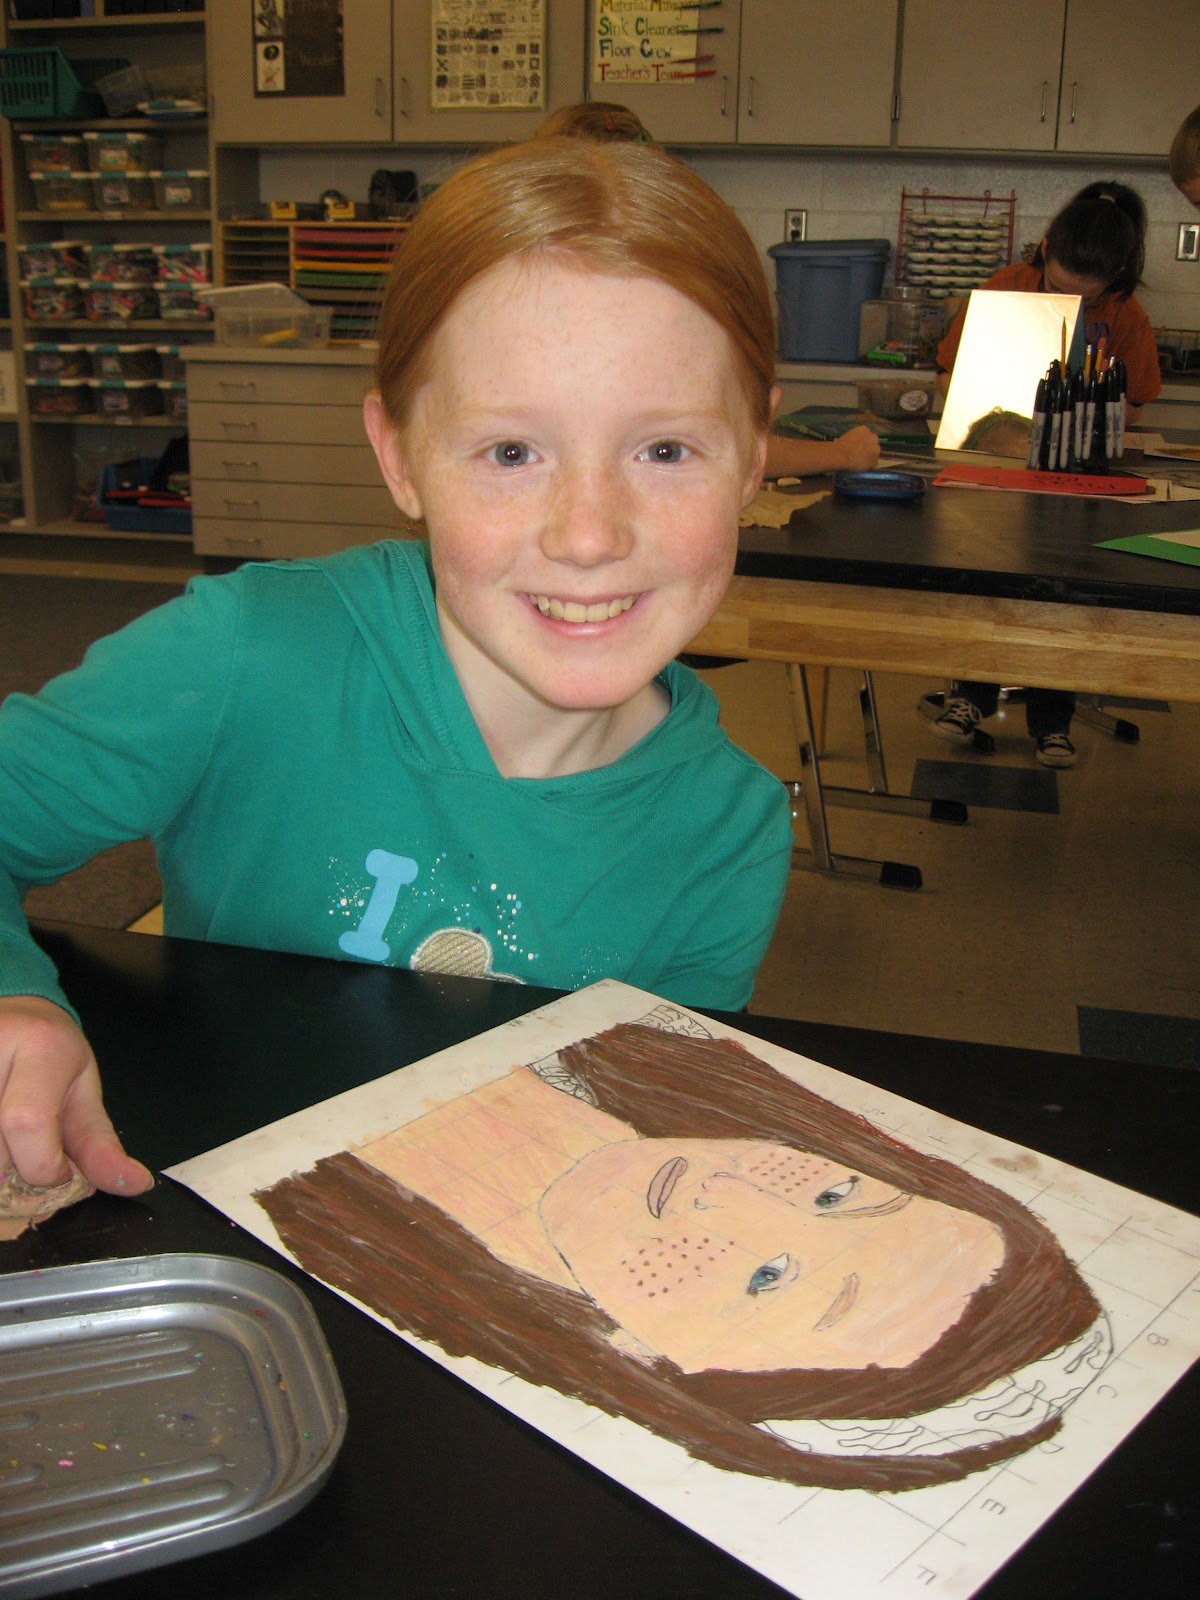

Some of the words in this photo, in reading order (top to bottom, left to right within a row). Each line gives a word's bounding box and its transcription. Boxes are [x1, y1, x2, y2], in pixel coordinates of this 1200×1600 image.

[598, 16, 628, 36] Sink
[599, 38, 634, 58] Floor
[640, 38, 672, 58] Crew
